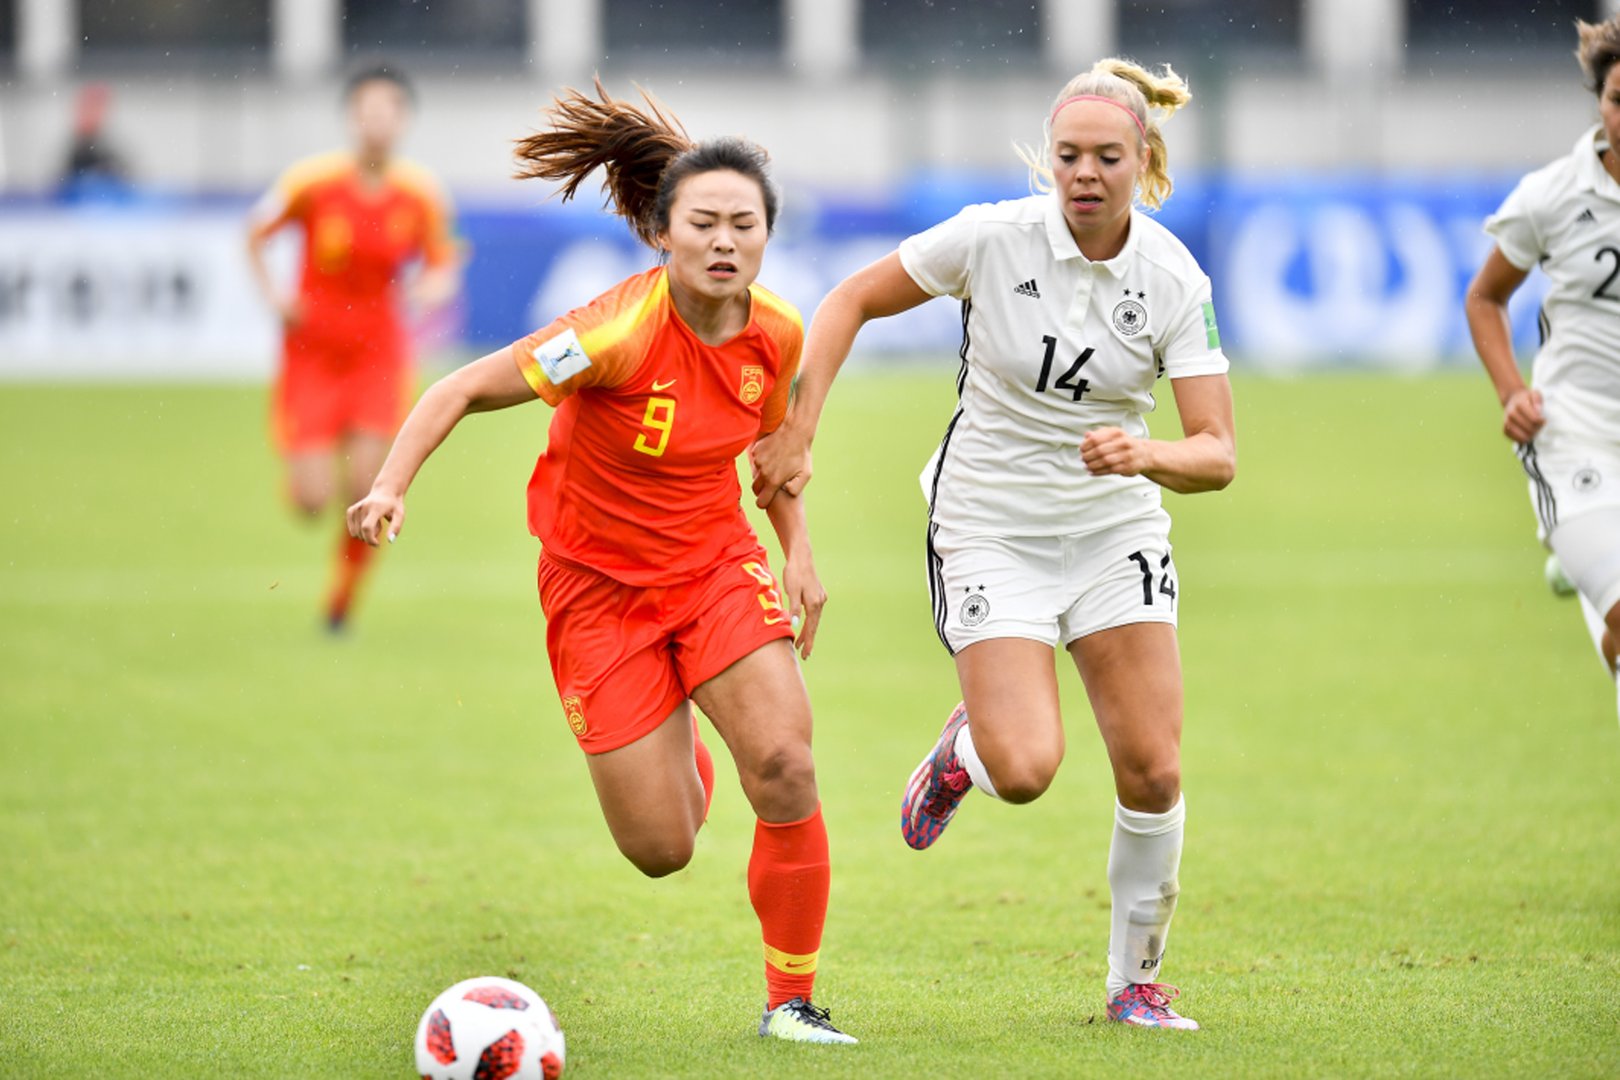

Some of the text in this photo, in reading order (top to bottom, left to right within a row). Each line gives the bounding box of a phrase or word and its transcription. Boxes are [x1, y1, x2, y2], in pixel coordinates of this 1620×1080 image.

[1013, 286, 1041, 299] adidas
[1592, 246, 1620, 300] 2
[1035, 335, 1095, 402] 14
[633, 397, 676, 457] 9
[741, 562, 782, 611] 9
[1127, 550, 1176, 612] 14
